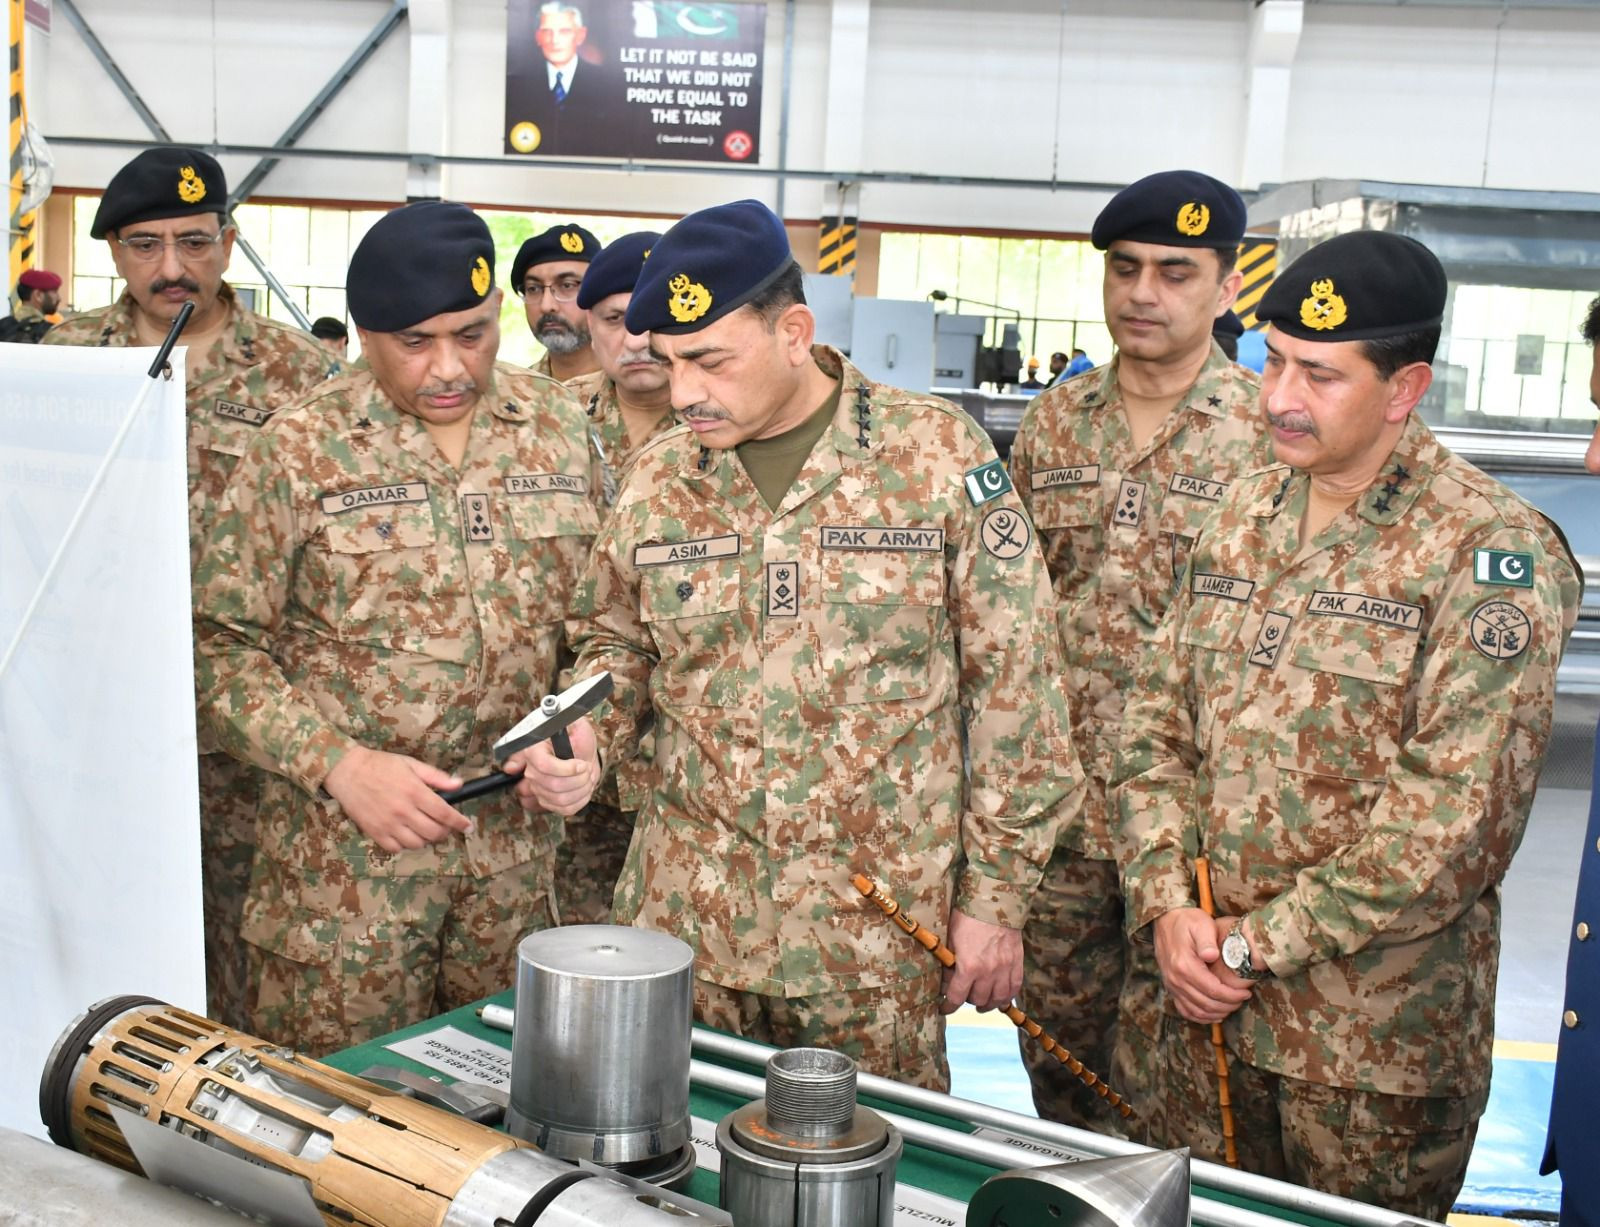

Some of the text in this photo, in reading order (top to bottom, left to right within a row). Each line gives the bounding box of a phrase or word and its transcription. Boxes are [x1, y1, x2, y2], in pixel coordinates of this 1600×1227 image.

[620, 47, 757, 68] LET IT NOT BE SAID
[624, 68, 753, 87] THAT WE DID NOT
[626, 88, 748, 107] PROVE EQUAL TO
[651, 108, 722, 126] THE TASK
[219, 403, 247, 418] PAK
[512, 477, 578, 490] PAK ARMY
[1043, 469, 1083, 485] JAWAD
[1179, 478, 1209, 495] PAK
[342, 487, 408, 507] QAMAR
[827, 531, 936, 547] PAK ARMY
[668, 543, 707, 560] ASIM
[1201, 578, 1234, 594] AAMER
[1318, 596, 1412, 624] PAK ARMY
[424, 1039, 461, 1056] GAUGE
[459, 1053, 489, 1067] PLUG
[1002, 1137, 1052, 1155] GAUGE
[893, 1204, 956, 1227] MUZZLE
